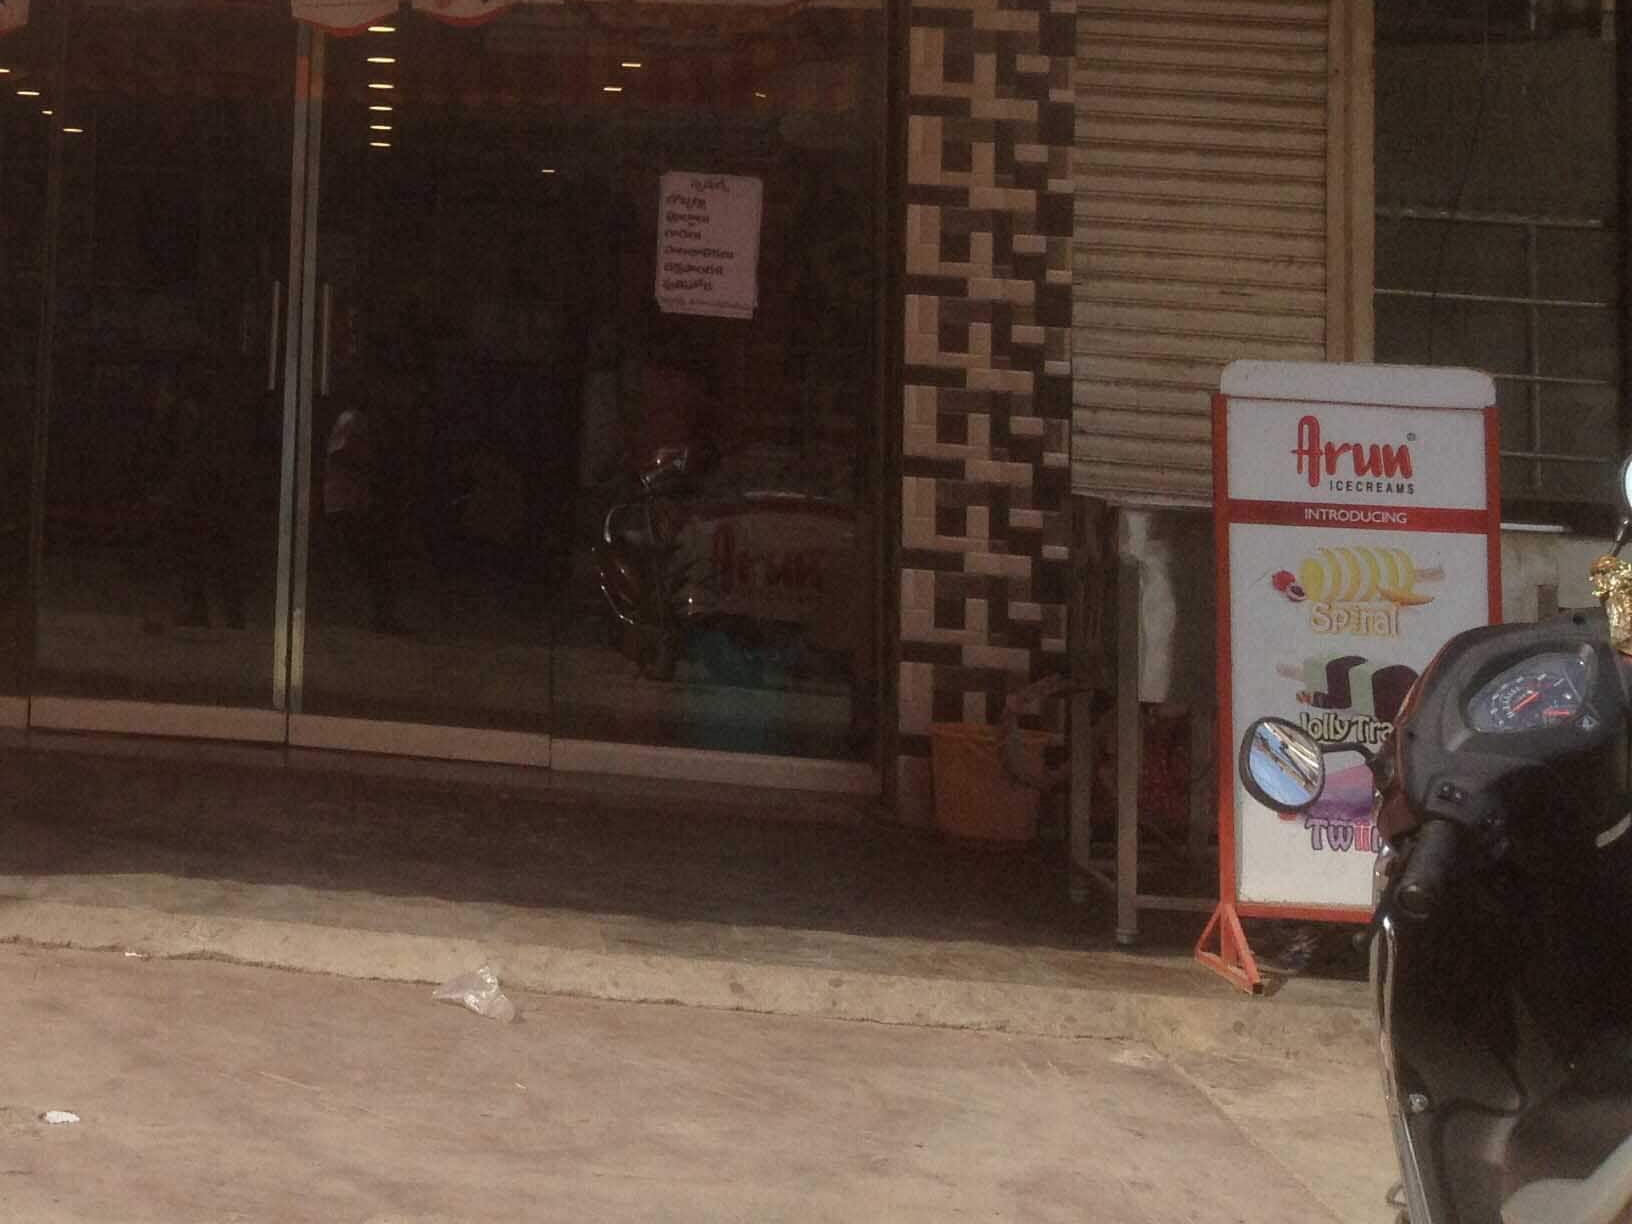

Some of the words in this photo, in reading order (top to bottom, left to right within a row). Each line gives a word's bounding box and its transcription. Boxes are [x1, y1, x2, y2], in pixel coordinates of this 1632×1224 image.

[1291, 415, 1414, 487] Arun
[1330, 480, 1415, 494] ICECREAMS
[1304, 508, 1408, 524] INTRODUCING
